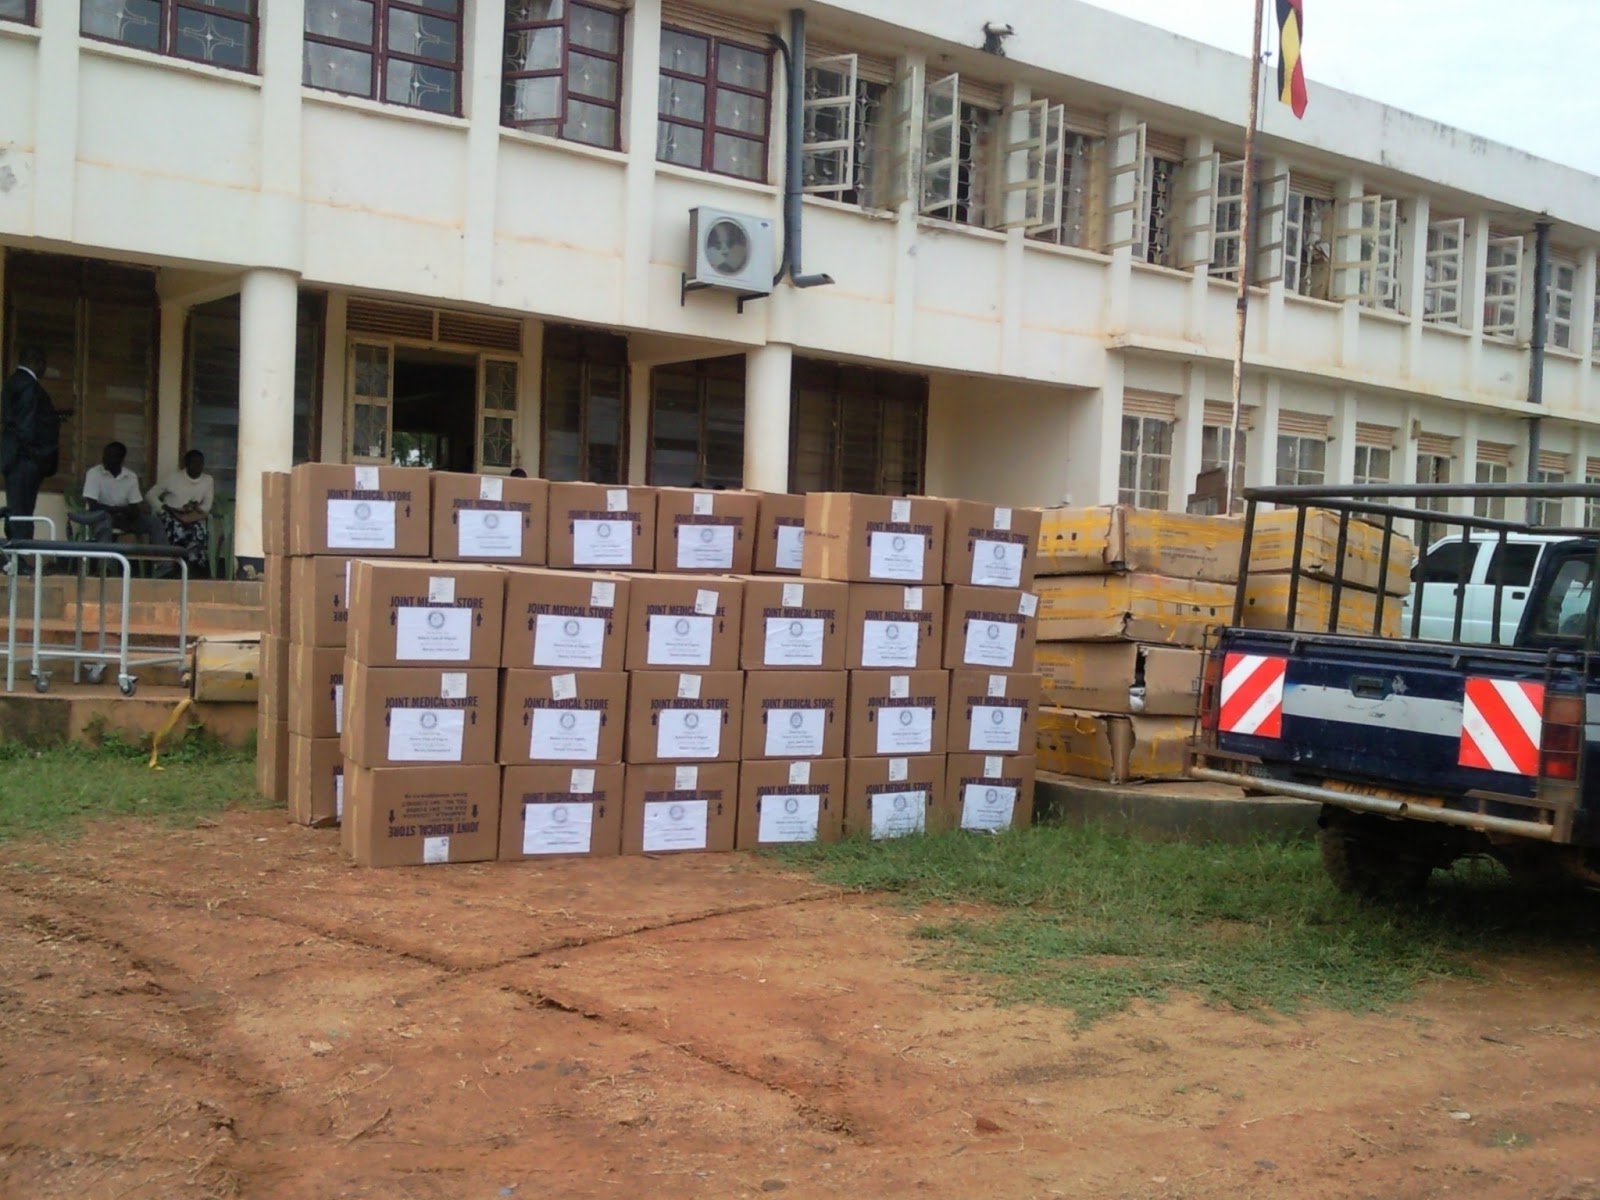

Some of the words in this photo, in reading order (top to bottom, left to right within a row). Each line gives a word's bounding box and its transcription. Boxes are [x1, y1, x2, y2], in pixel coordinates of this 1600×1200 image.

[327, 489, 349, 500] JOINT
[351, 489, 386, 501] MEDICAL
[387, 491, 412, 502] STORE
[866, 521, 884, 531] JOINT
[886, 522, 912, 533] MEDICAL
[390, 596, 415, 608] JOINT
[456, 598, 484, 609] STORE
[527, 602, 550, 615] JOINT
[552, 604, 587, 618] MEDICAL
[588, 606, 614, 620] STORE
[646, 604, 667, 615] JOINT
[763, 607, 782, 618] JOINT
[784, 608, 812, 619] MEDICAL
[814, 609, 836, 620] STORE
[865, 610, 883, 621] JOINT
[884, 610, 911, 622] MEDICAL
[912, 612, 933, 623] STORE
[385, 696, 409, 708] JOINT
[411, 697, 449, 708] MEDICAL
[451, 696, 478, 708] STORE
[523, 697, 546, 709] JOINT
[548, 698, 582, 710] MEDICAL
[584, 698, 609, 710] STORE
[650, 698, 671, 709] JOINT
[672, 698, 703, 709] MEDICAL
[706, 698, 730, 709] STORE
[761, 698, 780, 709] JOINT
[782, 698, 810, 709] MEDICAL
[812, 698, 835, 709] STORE
[867, 696, 886, 707] JOINT
[887, 697, 915, 708] MEDICAL
[916, 696, 937, 707] STORE
[757, 786, 776, 796] JOINT
[777, 785, 808, 796] MEDICAL
[808, 783, 830, 795] STORE
[866, 784, 884, 795] JOINT
[885, 783, 912, 794] MEDICAL
[912, 781, 933, 792] STORE
[388, 825, 416, 838] STORE
[419, 823, 451, 836] MEDICAL
[453, 821, 479, 834] JOINT
